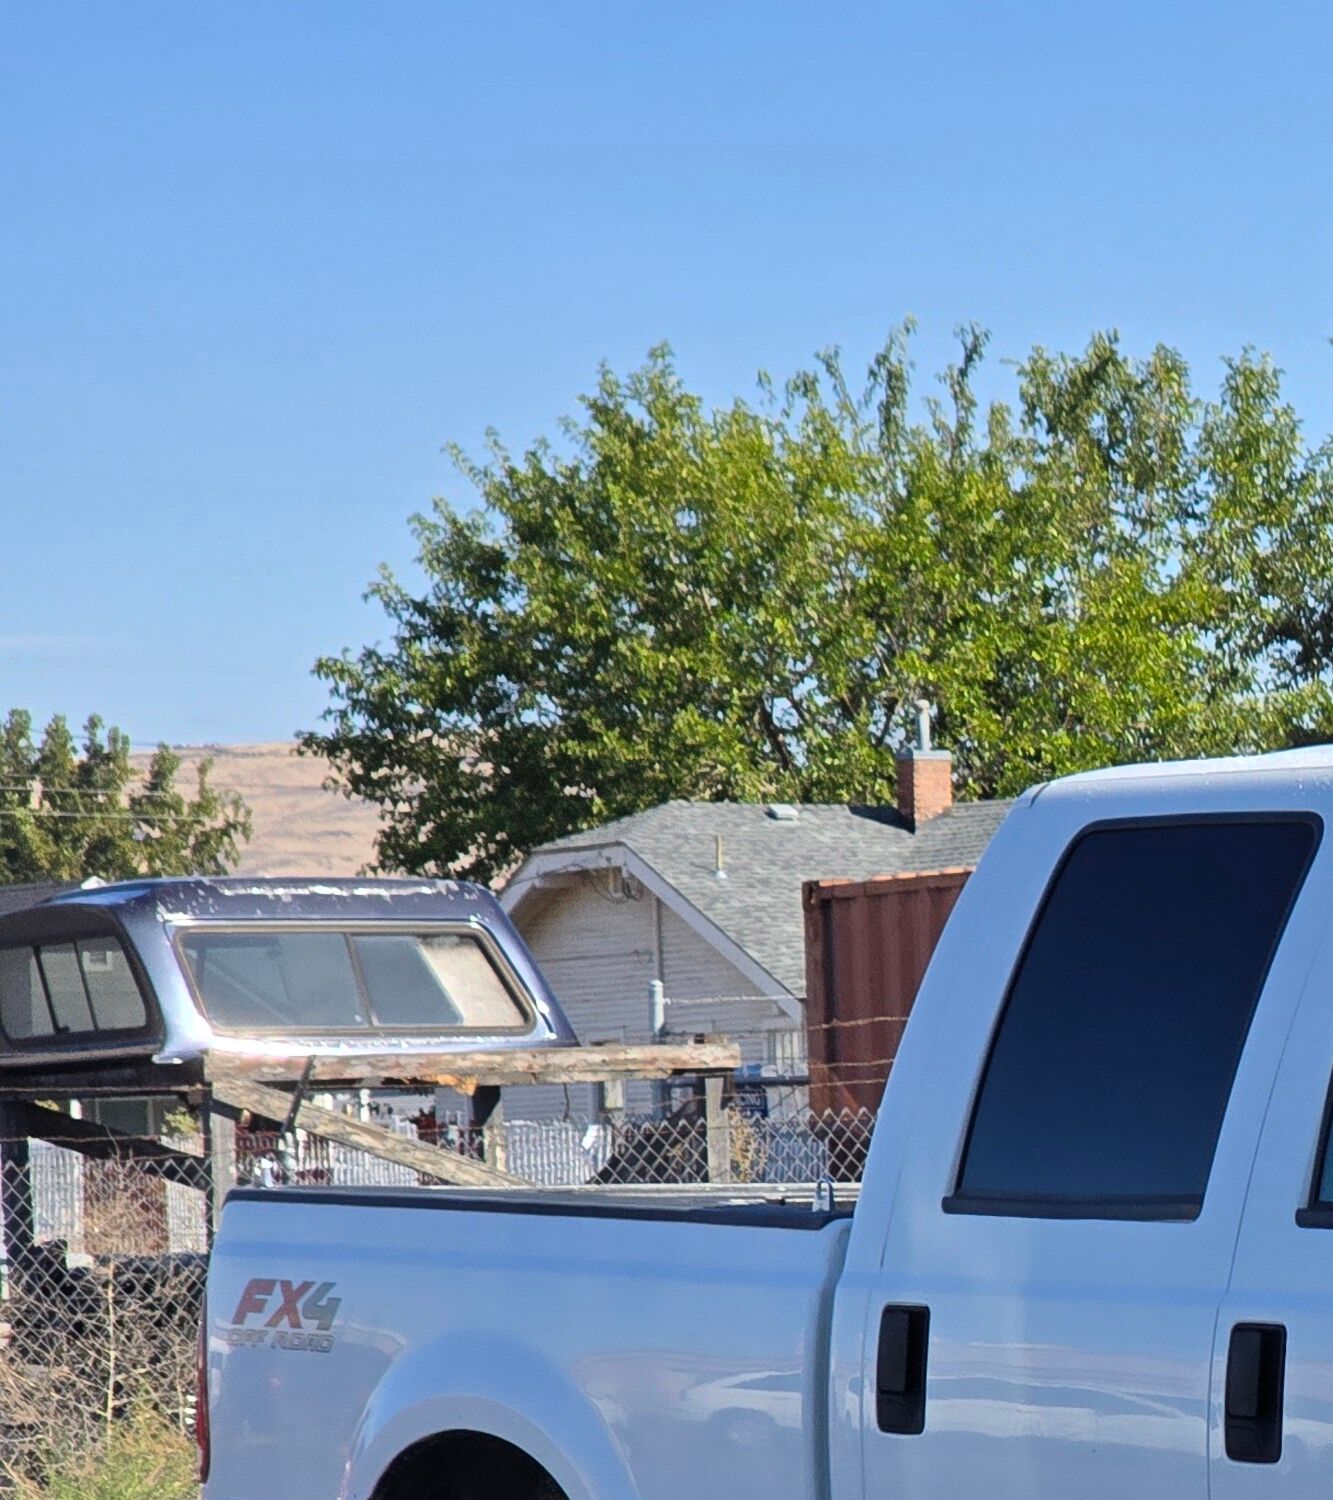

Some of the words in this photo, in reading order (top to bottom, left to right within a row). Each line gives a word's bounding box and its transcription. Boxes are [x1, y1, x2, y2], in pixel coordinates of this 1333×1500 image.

[231, 1278, 342, 1331] FX4
[227, 1328, 268, 1347] OFF
[270, 1330, 335, 1353] ROAD
